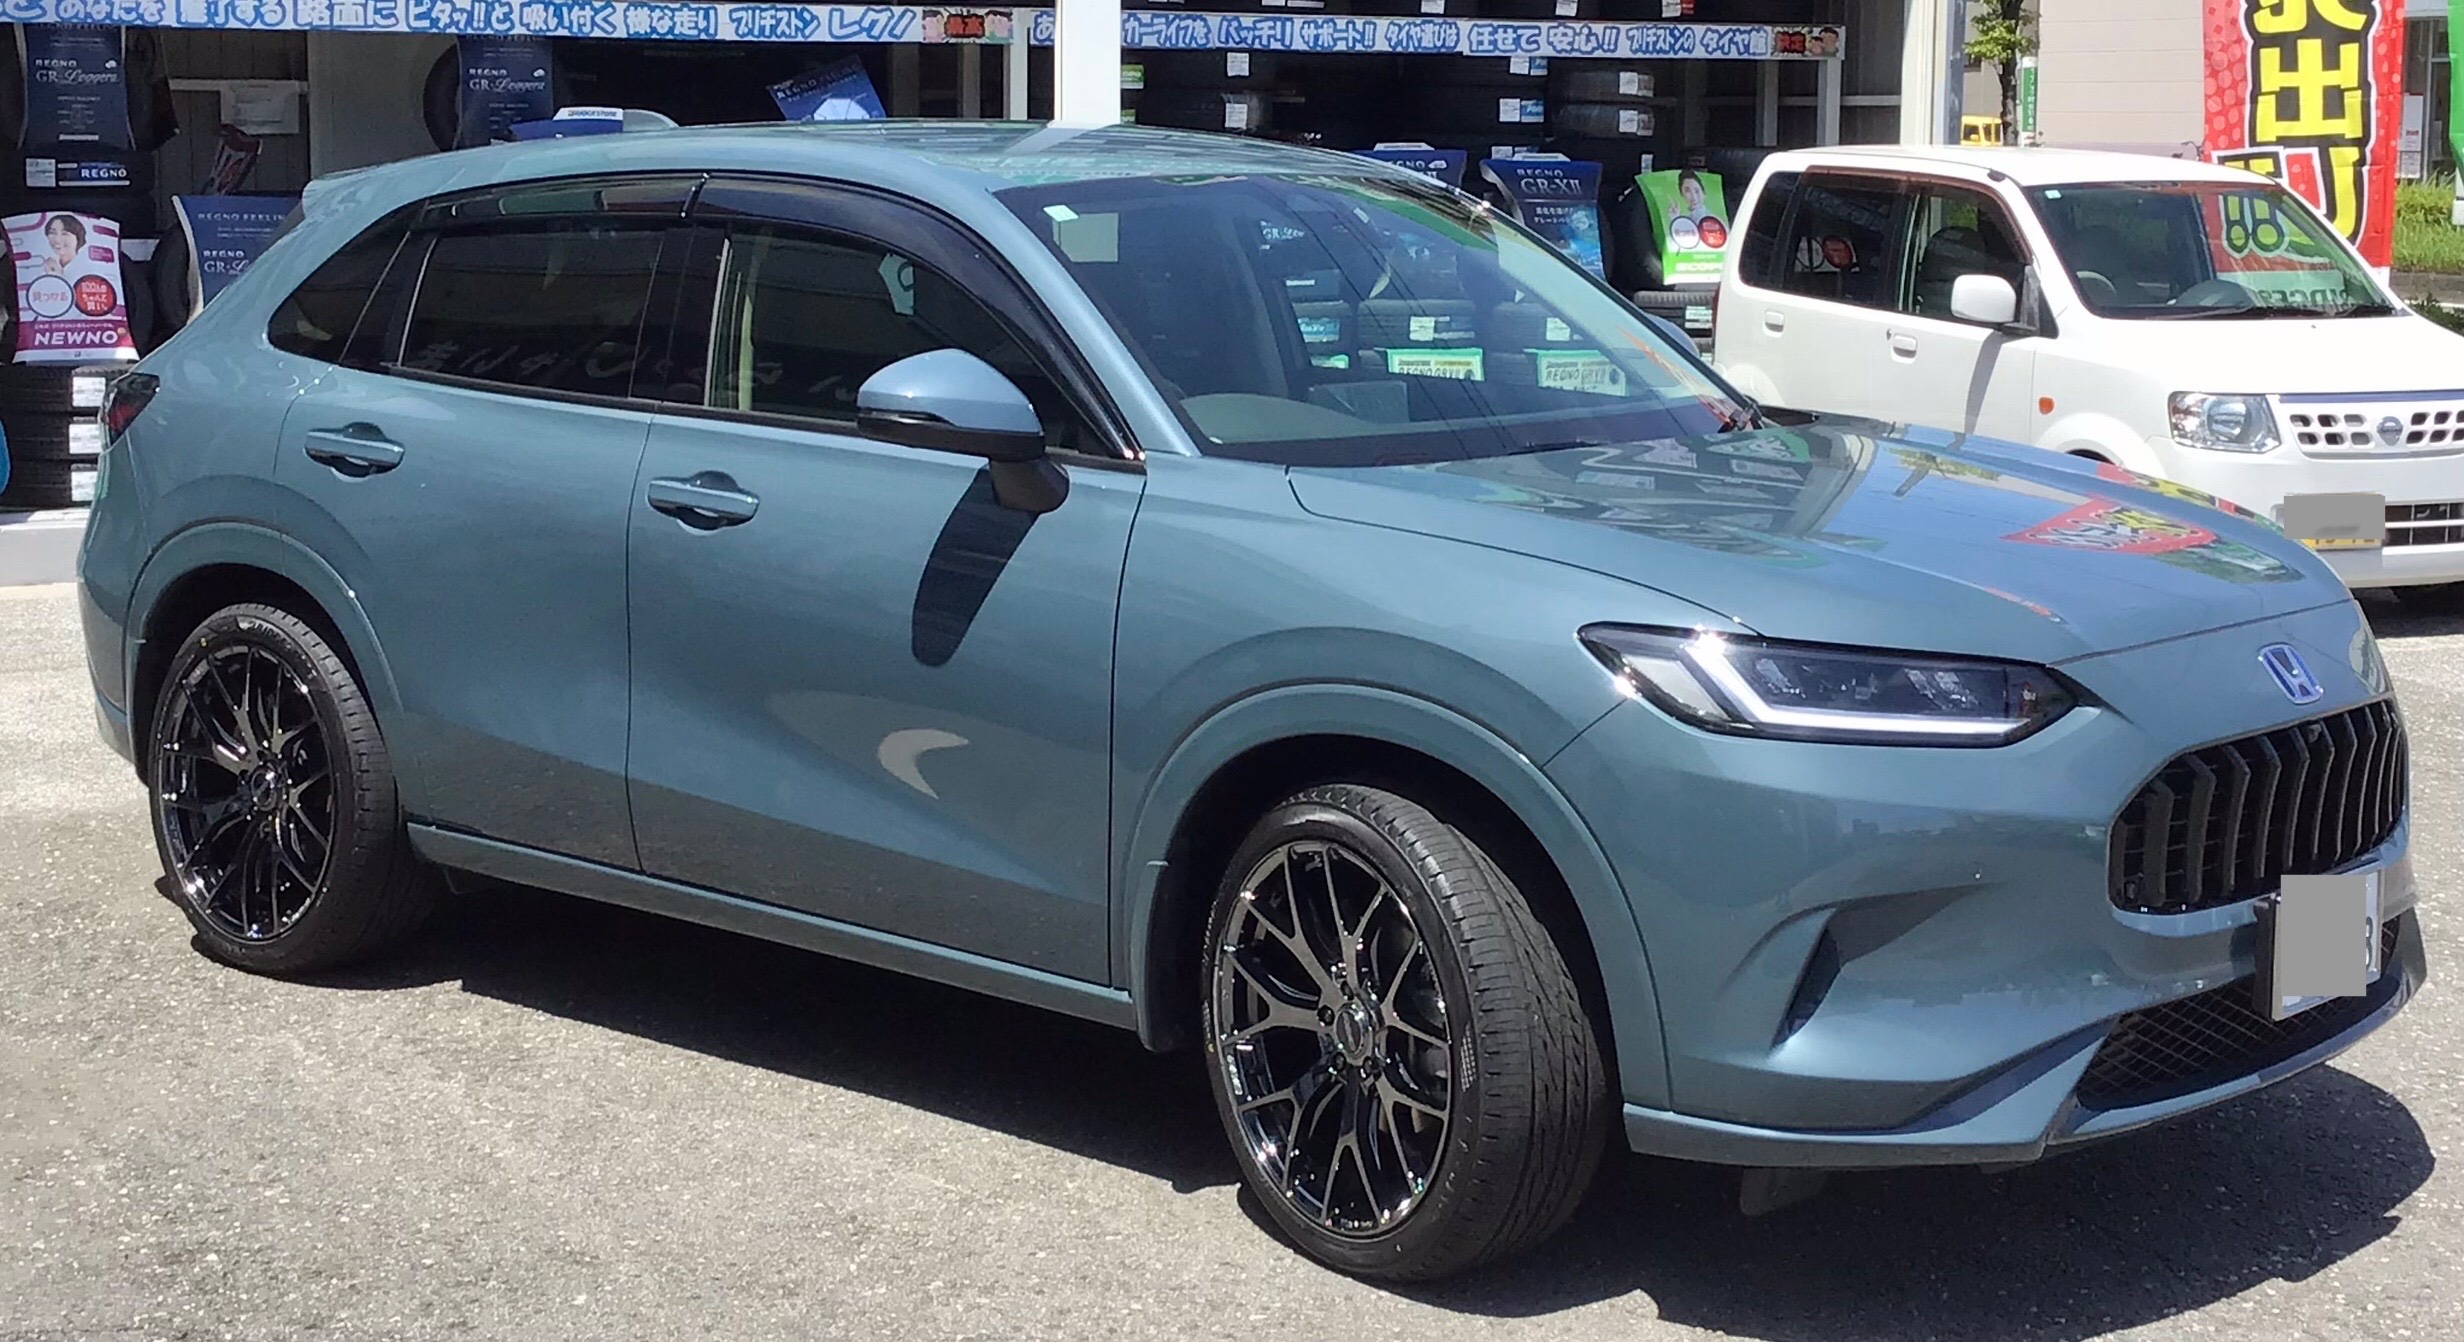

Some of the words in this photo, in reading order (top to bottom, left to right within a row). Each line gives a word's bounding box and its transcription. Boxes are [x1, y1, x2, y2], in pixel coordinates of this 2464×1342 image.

[294, 0, 399, 28] 路面に
[519, 1, 617, 34] 吸い付く
[829, 8, 917, 41] レグノ
[1468, 22, 1541, 54] 任せて
[81, 168, 128, 179] REGNO
[1517, 168, 1564, 178] REGNO
[203, 250, 245, 258] REGNO
[34, 330, 119, 346] NEWNO
